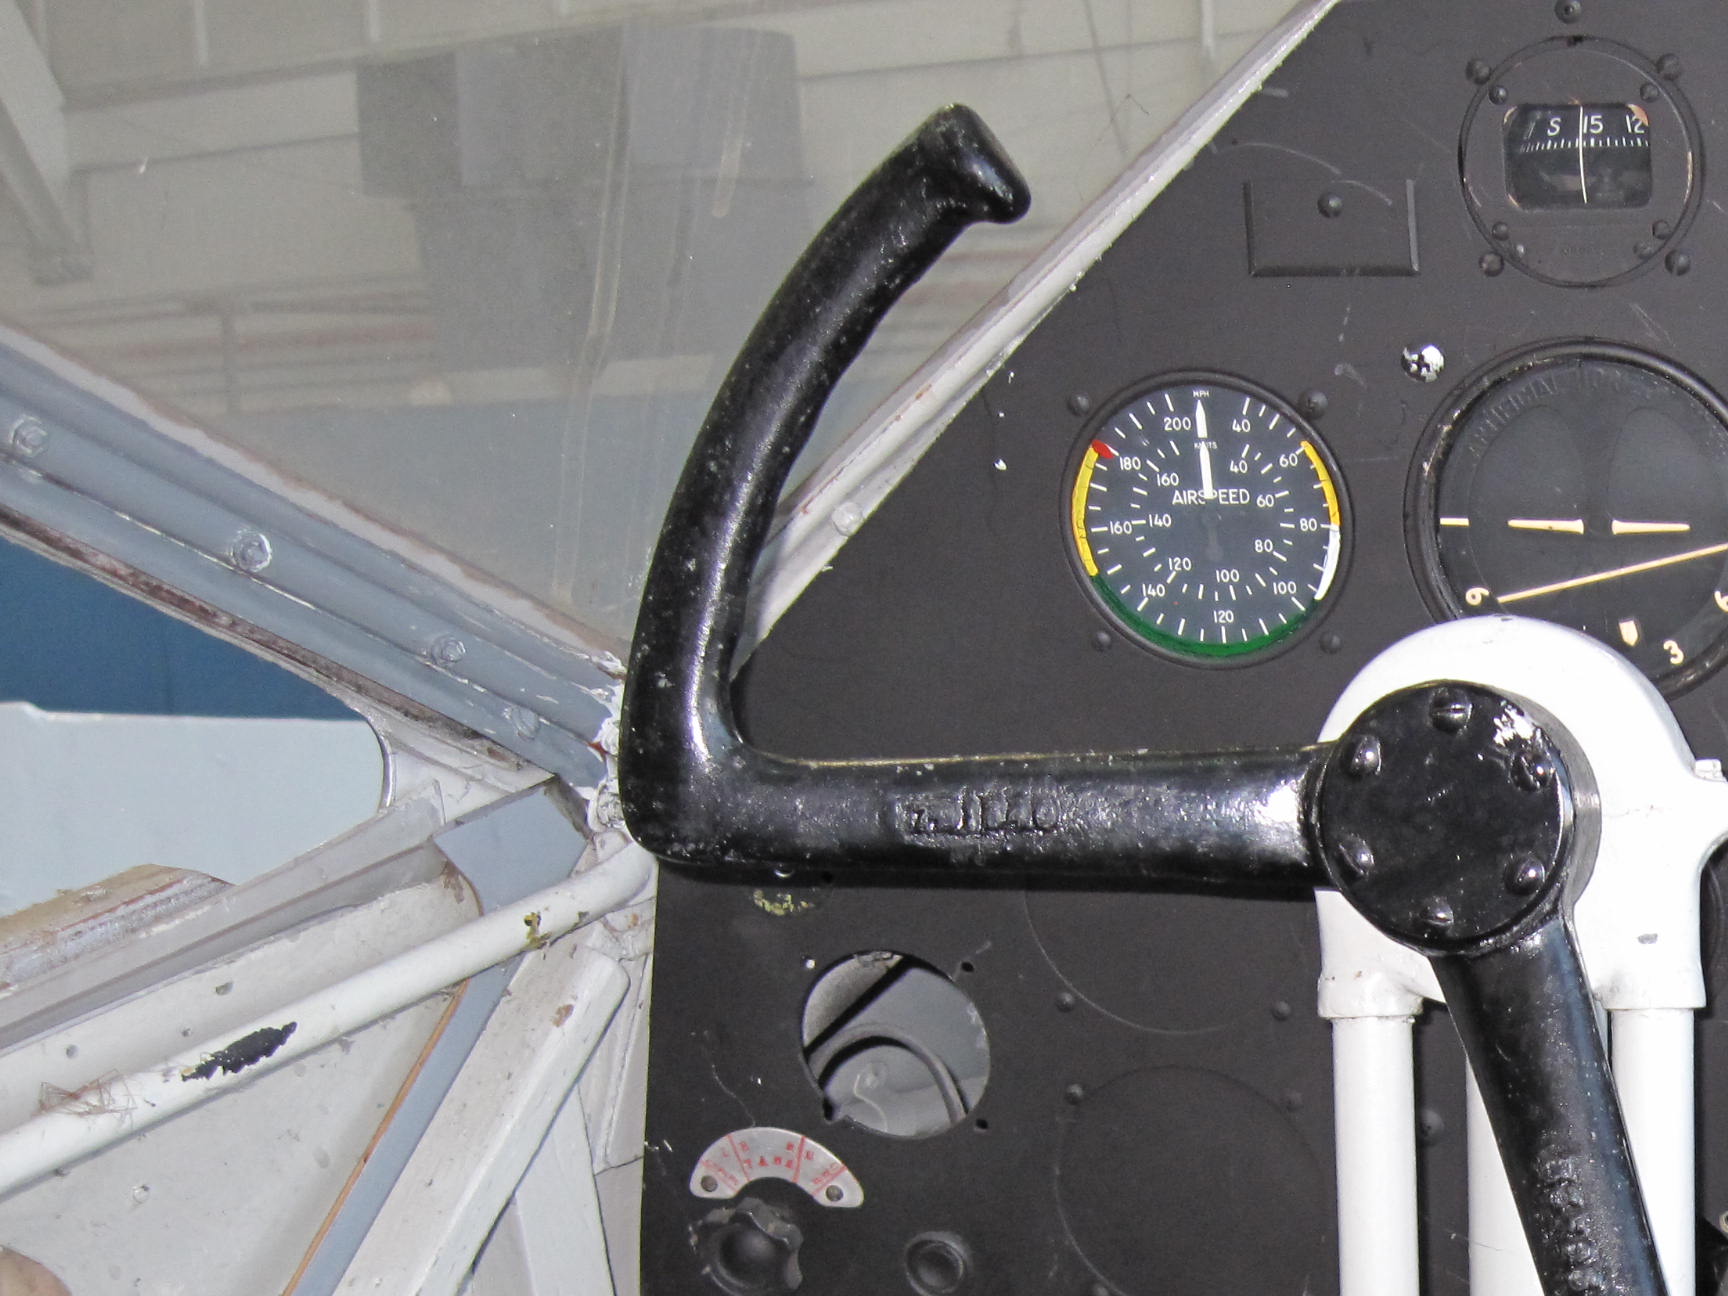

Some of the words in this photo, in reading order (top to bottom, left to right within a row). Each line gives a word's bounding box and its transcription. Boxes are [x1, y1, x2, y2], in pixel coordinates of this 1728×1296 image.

[1547, 117, 1561, 136] S
[1583, 115, 1604, 134] 15
[1625, 114, 1646, 134] 12
[1192, 390, 1210, 398] MPH
[1164, 417, 1191, 431] 200
[1232, 419, 1251, 433] 40
[1193, 441, 1218, 450] KNTS
[1119, 457, 1141, 470] 180
[1230, 460, 1248, 473] 40
[1279, 453, 1298, 467] 60
[1157, 473, 1179, 486] 160
[1256, 494, 1275, 507] 60
[1149, 514, 1172, 528] 140
[1300, 518, 1318, 531] 80
[1109, 521, 1132, 535] 160
[1254, 539, 1273, 552] 80
[1168, 557, 1192, 571] 120
[1216, 569, 1239, 582] 100
[1142, 583, 1165, 597] 140
[1273, 582, 1297, 595] 100
[1213, 610, 1234, 623] 120
[1663, 639, 1685, 664] 3
